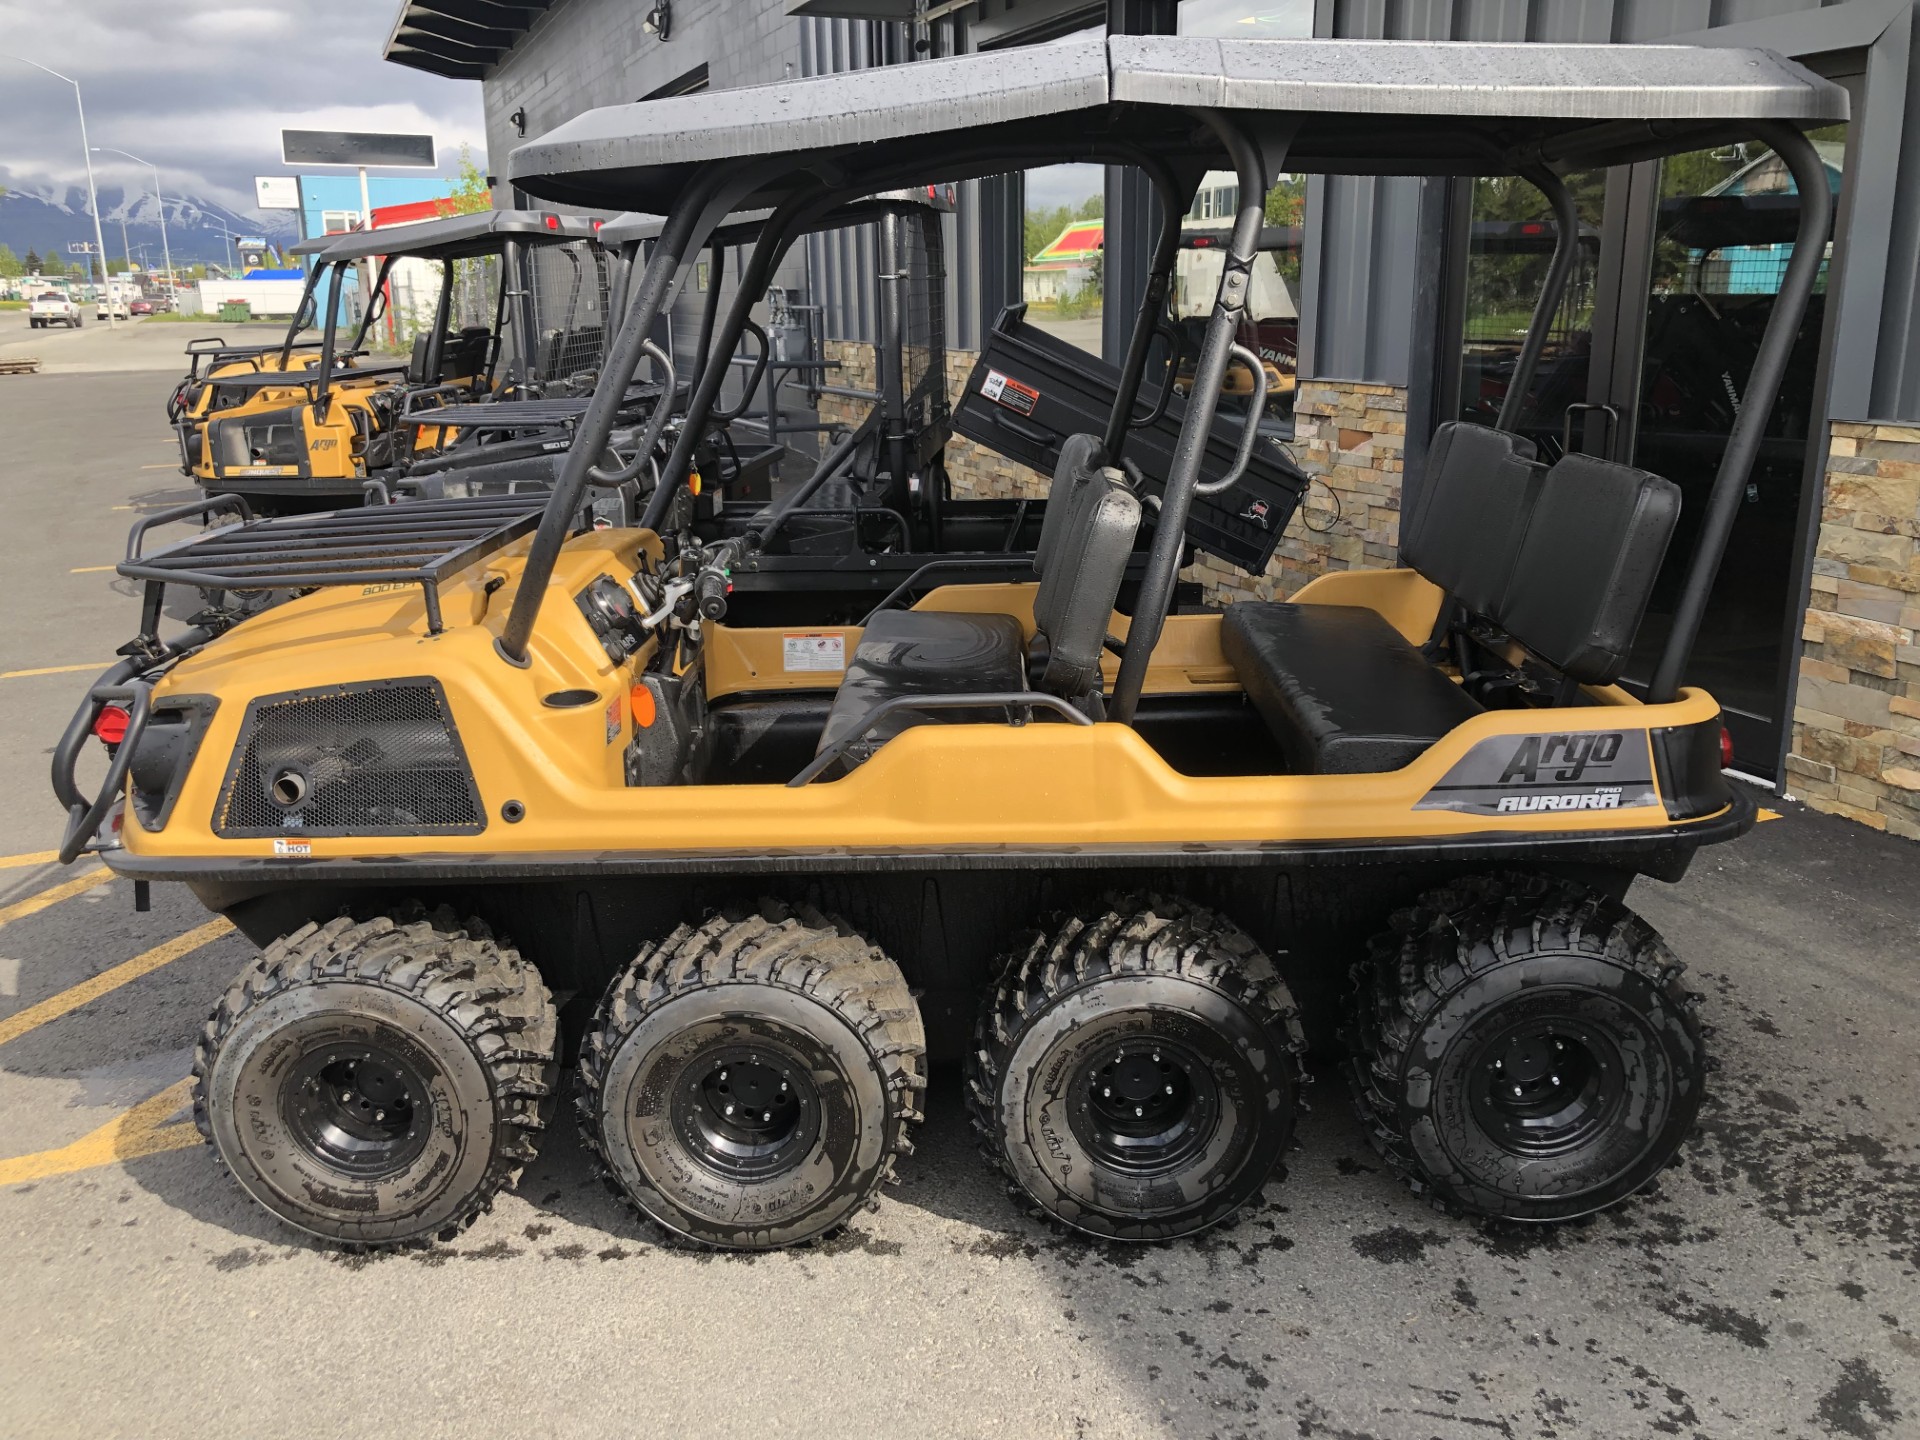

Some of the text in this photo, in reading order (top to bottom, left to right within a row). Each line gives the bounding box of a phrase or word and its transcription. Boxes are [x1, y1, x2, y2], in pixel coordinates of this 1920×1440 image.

[1259, 347, 1297, 367] YANM
[1721, 370, 1741, 414] YANMA
[310, 439, 338, 451] Argo
[362, 584, 390, 596] 800
[1498, 733, 1623, 784] Argo
[1496, 793, 1621, 812] AURORA
[287, 845, 309, 853] HOT
